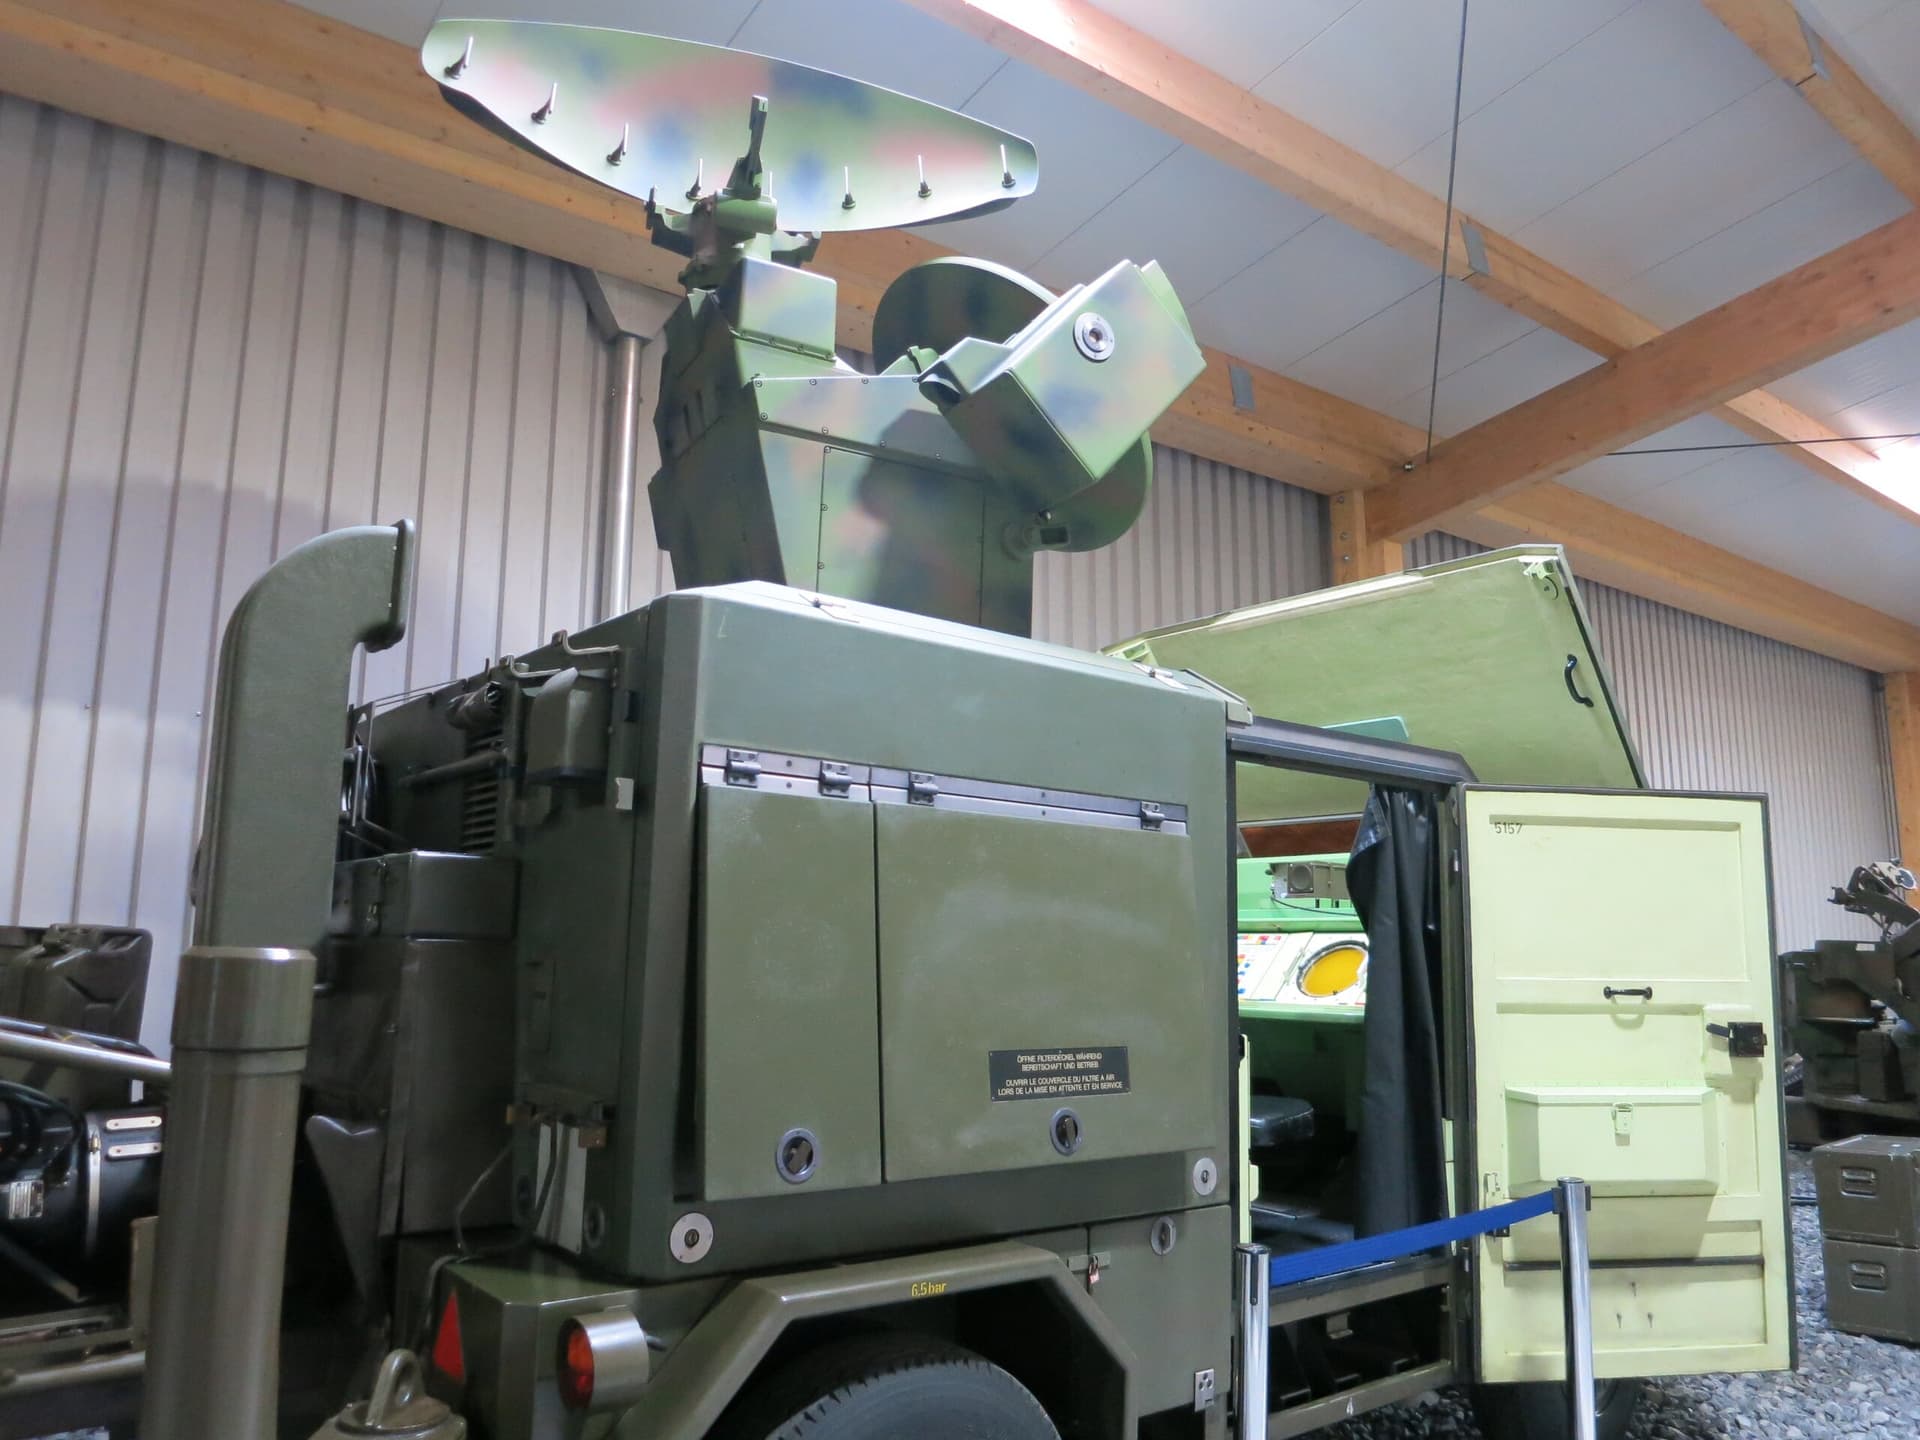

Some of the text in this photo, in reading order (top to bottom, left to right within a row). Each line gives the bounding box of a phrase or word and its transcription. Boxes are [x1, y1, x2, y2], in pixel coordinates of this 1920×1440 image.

[1491, 822, 1523, 835] 5157
[1021, 1061, 1099, 1072] BEREITSCHAFT UND BETRIEB
[1005, 1079, 1028, 1087] OUVRIR
[1029, 1078, 1037, 1086] LE
[1037, 1076, 1072, 1085] COUVERCLE
[1072, 1075, 1081, 1083] DU
[1082, 1074, 1100, 1083] FILTRE
[1105, 1073, 1115, 1081] AIR
[998, 1081, 1123, 1096] LORS DE LA MISE EN ATTENTE ET EN SERVICE
